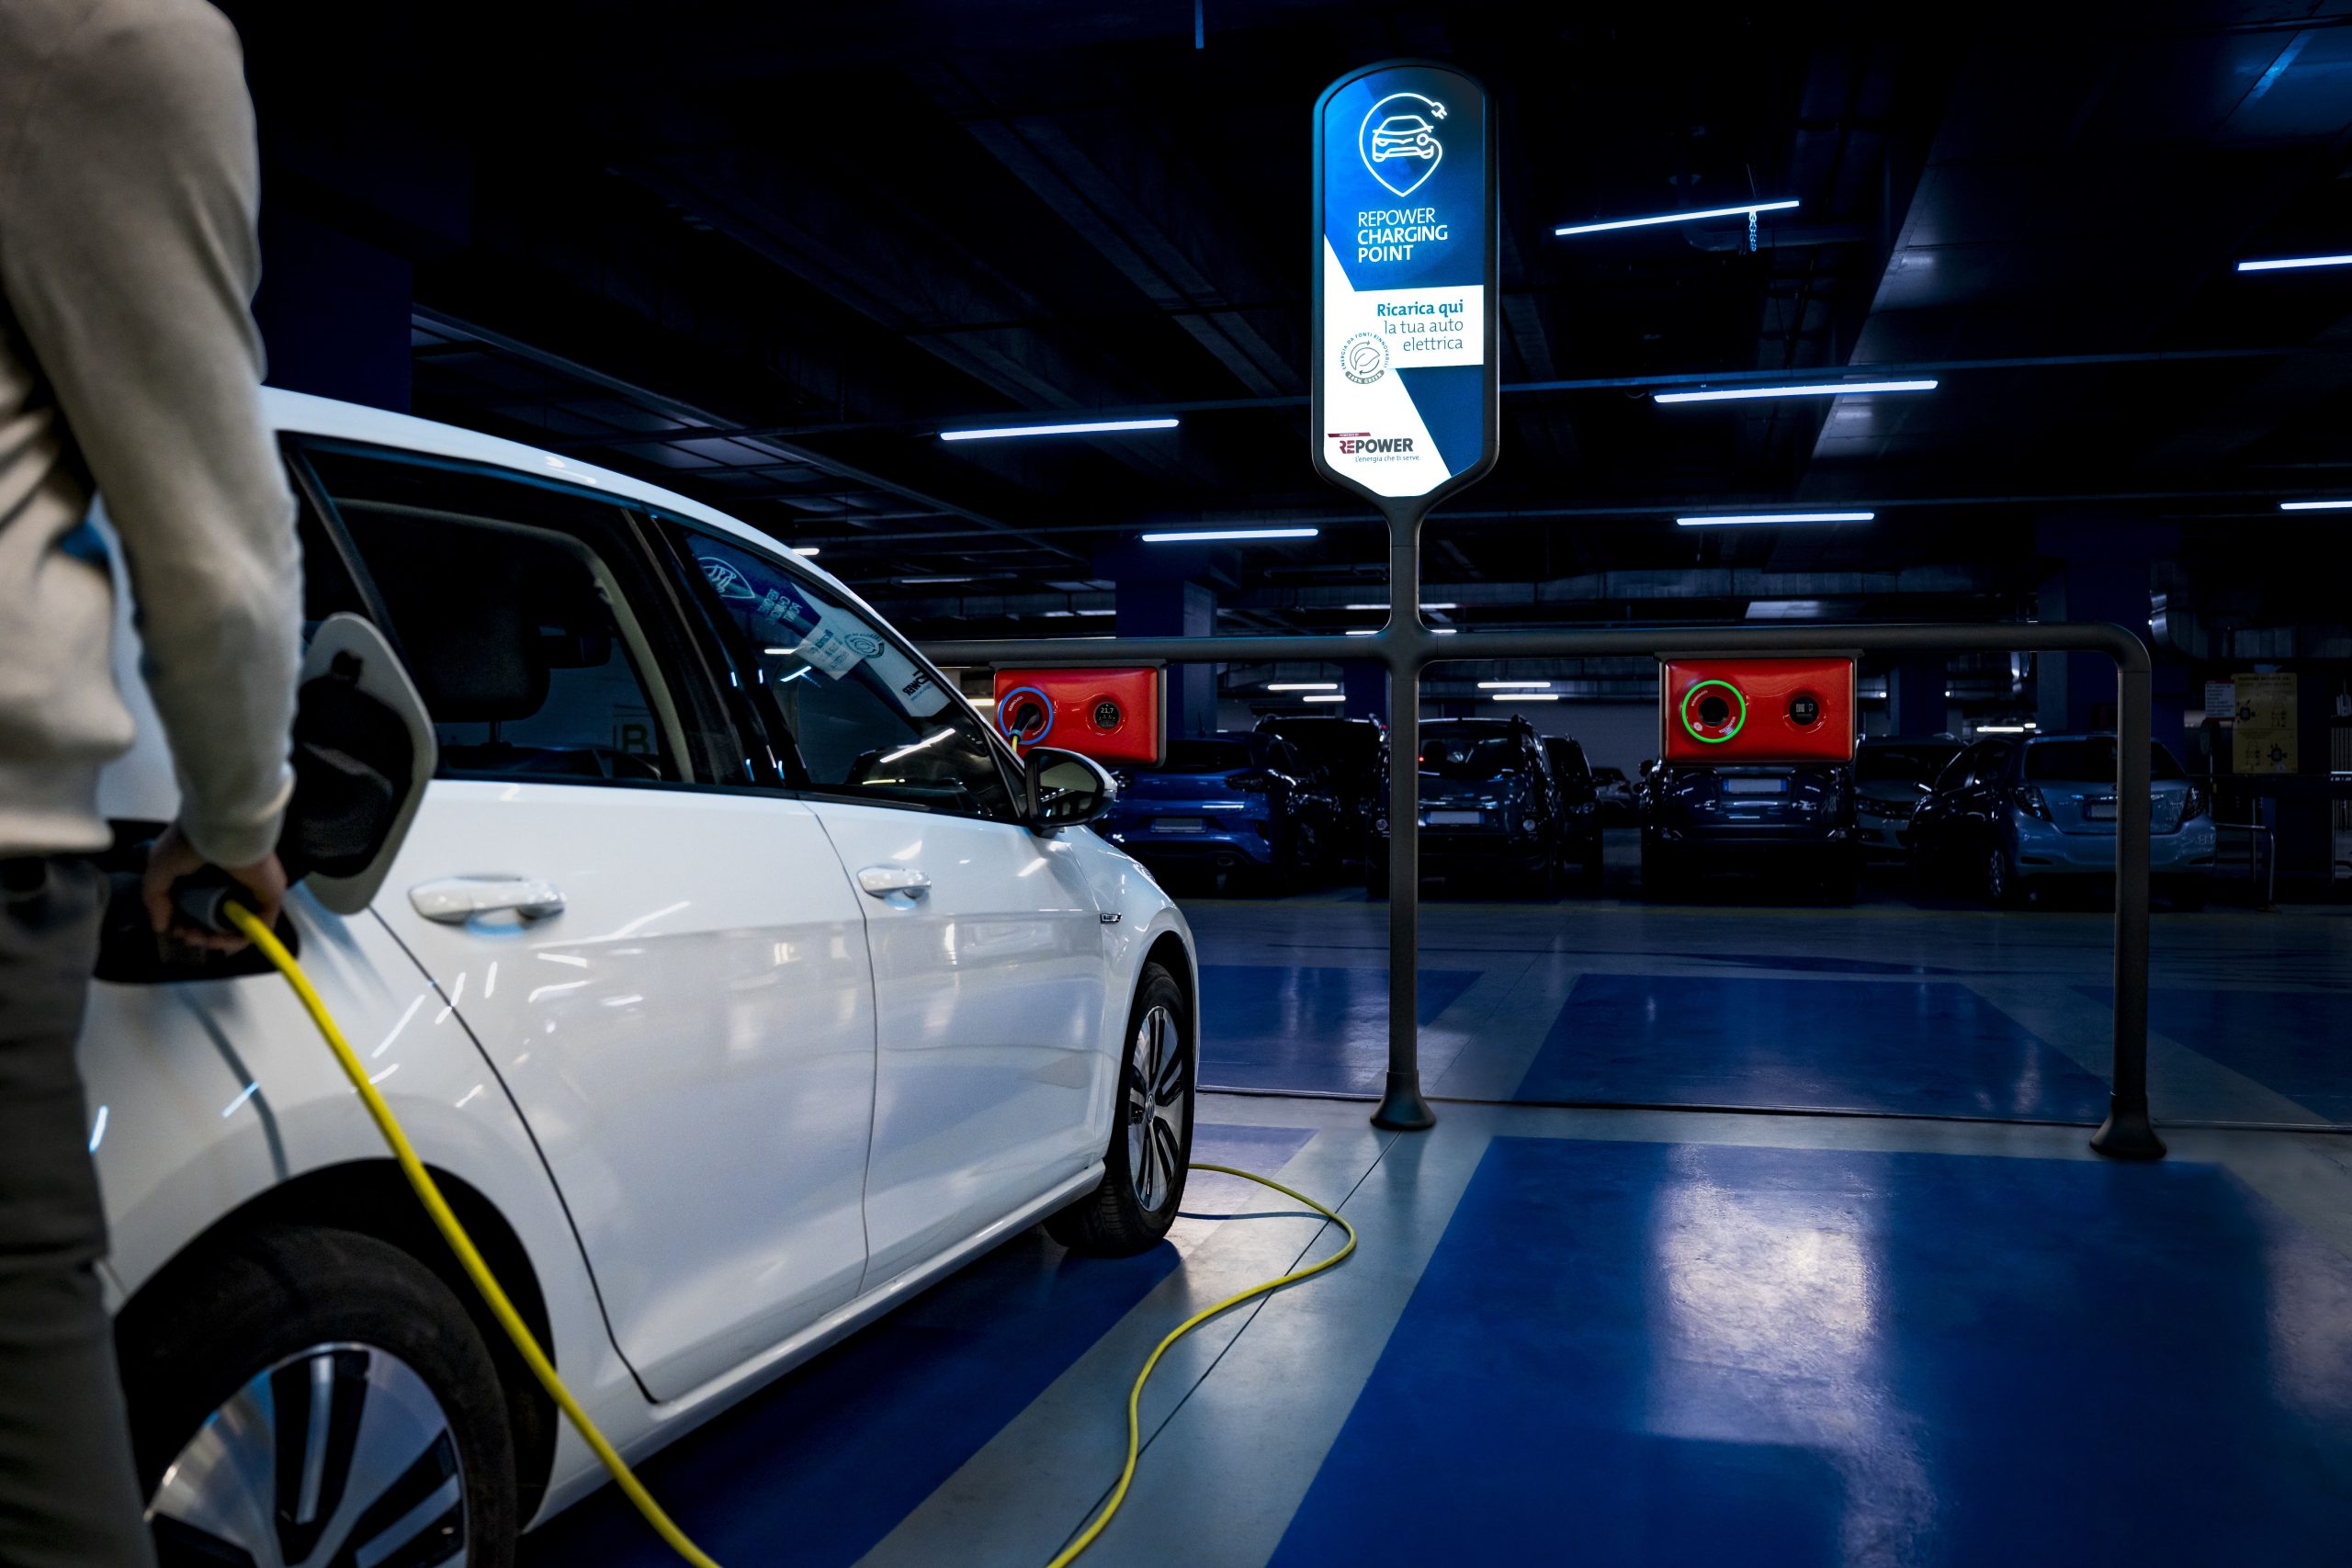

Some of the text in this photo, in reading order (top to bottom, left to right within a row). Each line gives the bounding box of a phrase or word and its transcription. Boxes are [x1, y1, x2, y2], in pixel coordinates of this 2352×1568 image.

[1358, 208, 1435, 227] REPOWER
[1357, 225, 1448, 244] CHARGING
[1358, 245, 1414, 263] POINT
[1377, 299, 1464, 318] Ricarica qui
[1385, 319, 1464, 334] la tua auto
[1403, 335, 1463, 351] elettrica
[1340, 438, 1413, 454] REPOWER
